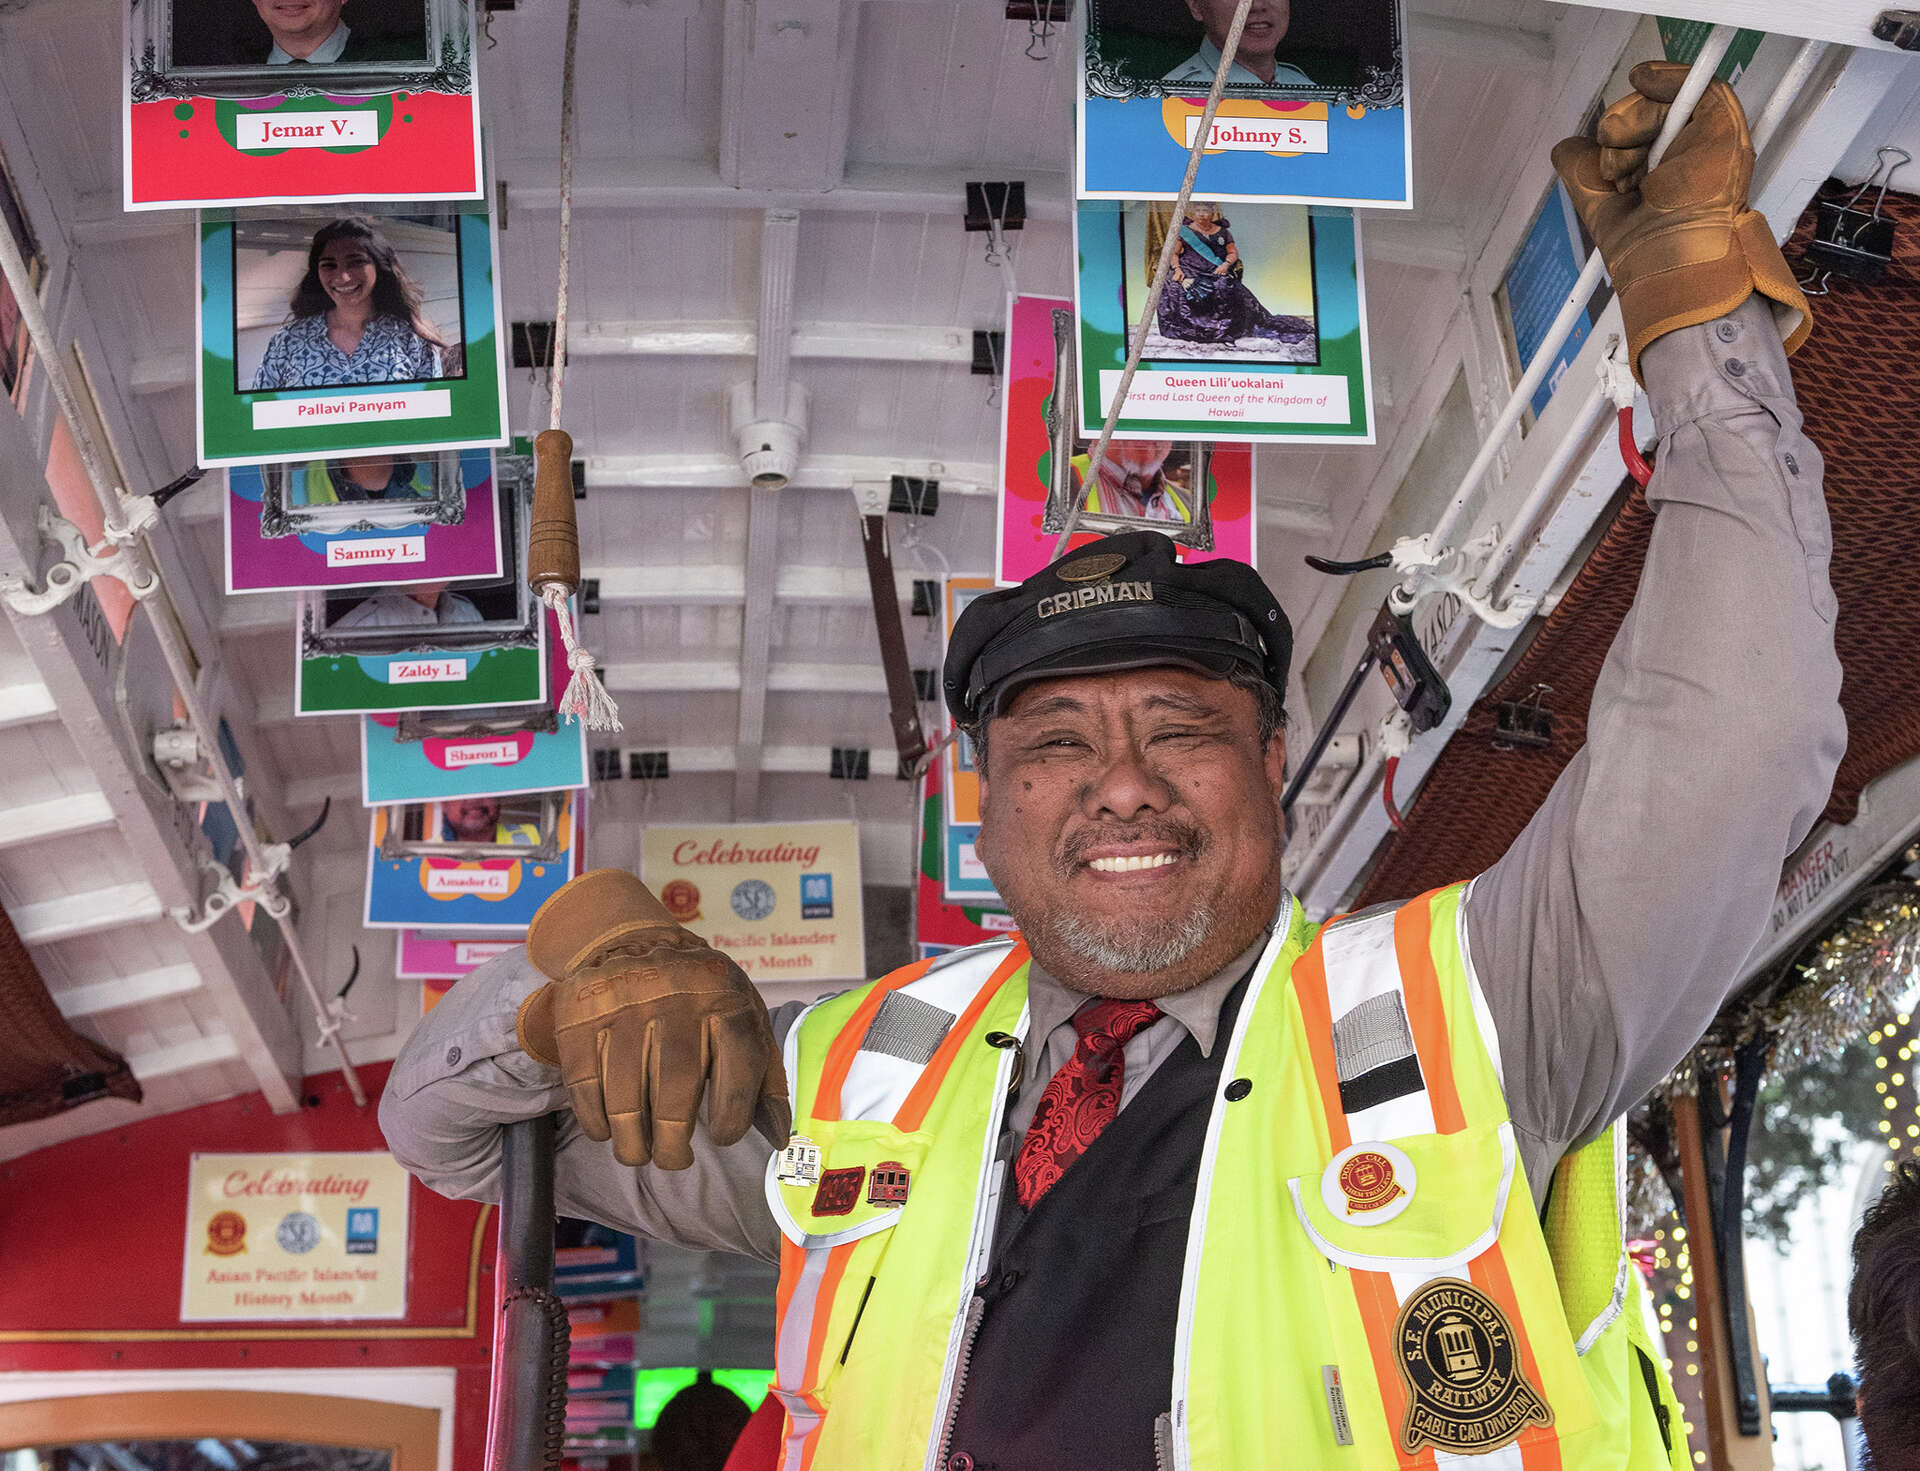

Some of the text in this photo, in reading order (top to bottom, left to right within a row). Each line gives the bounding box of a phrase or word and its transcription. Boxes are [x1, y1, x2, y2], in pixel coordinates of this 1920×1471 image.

[261, 119, 355, 142] Jemar V.
[1210, 125, 1307, 147] Johnny S.
[1165, 376, 1207, 388] Queen
[298, 400, 406, 416] Pallavi Panyam
[1149, 392, 1170, 401] and
[1172, 392, 1194, 402] Last
[1196, 392, 1231, 403] Queen
[1233, 394, 1245, 405] of
[1247, 394, 1264, 404] the
[1267, 395, 1313, 407] Kingdom
[1316, 395, 1328, 408] of
[1208, 407, 1245, 418] Hawaii
[334, 543, 420, 561] Sammy L.
[1037, 580, 1154, 619] GRIPMAN
[398, 663, 461, 679] Zaldy L.
[450, 750, 498, 762] Sharon
[672, 838, 821, 869] Celebrating
[713, 931, 837, 948] Pacific Islander
[759, 954, 814, 970] Month
[1365, 1154, 1387, 1167] CALL
[223, 1169, 370, 1202] Celebrating
[235, 1291, 354, 1309] History Month
[1405, 1290, 1508, 1362] S.F. MUNICIPAL
[1426, 1367, 1506, 1407] RAILWAY
[1414, 1392, 1534, 1442] CABLE CAR DIVISION
